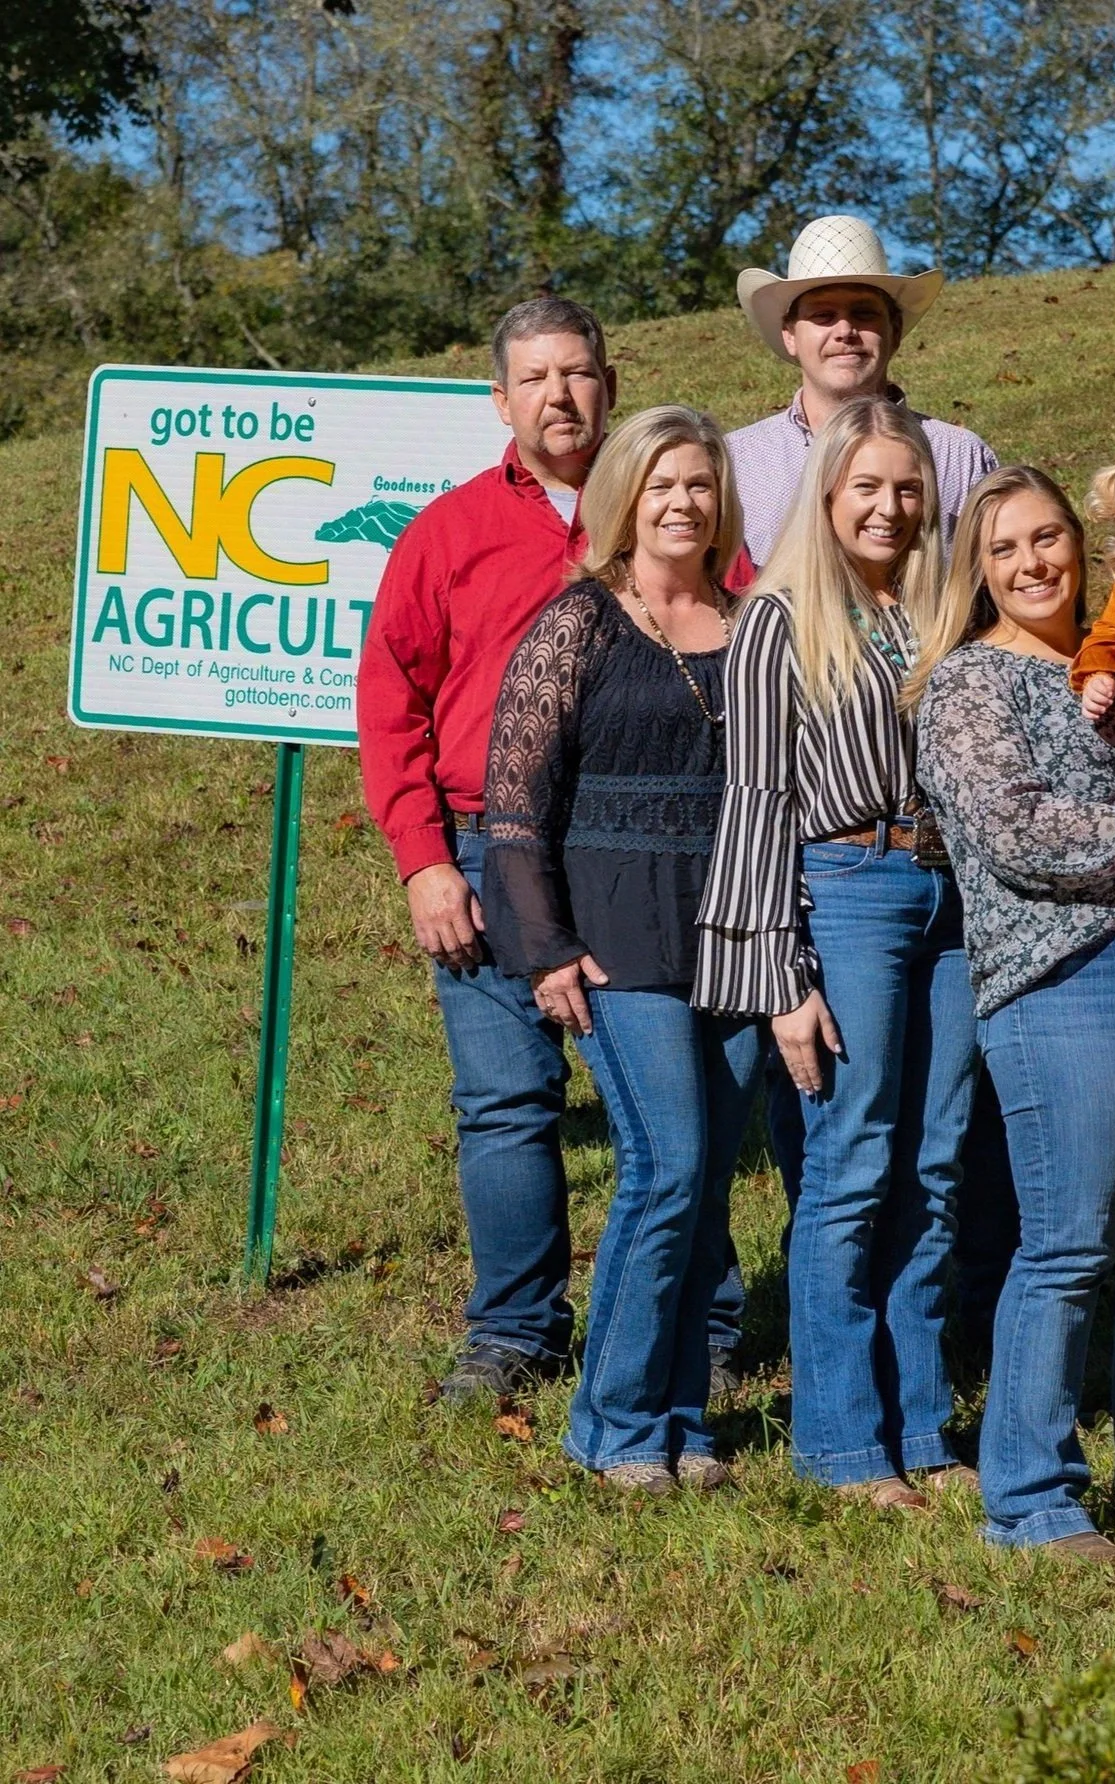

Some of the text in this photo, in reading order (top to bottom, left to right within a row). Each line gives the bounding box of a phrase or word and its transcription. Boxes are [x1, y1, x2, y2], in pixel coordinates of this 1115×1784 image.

[150, 402, 316, 446] got to be
[373, 475, 435, 493] Goodness
[96, 447, 336, 586] NC
[109, 655, 134, 673] NC
[141, 657, 179, 679] Dept
[186, 660, 202, 677] of
[208, 661, 295, 683] Agriculture
[302, 667, 315, 684] &
[225, 687, 352, 711] gottobenc.com
